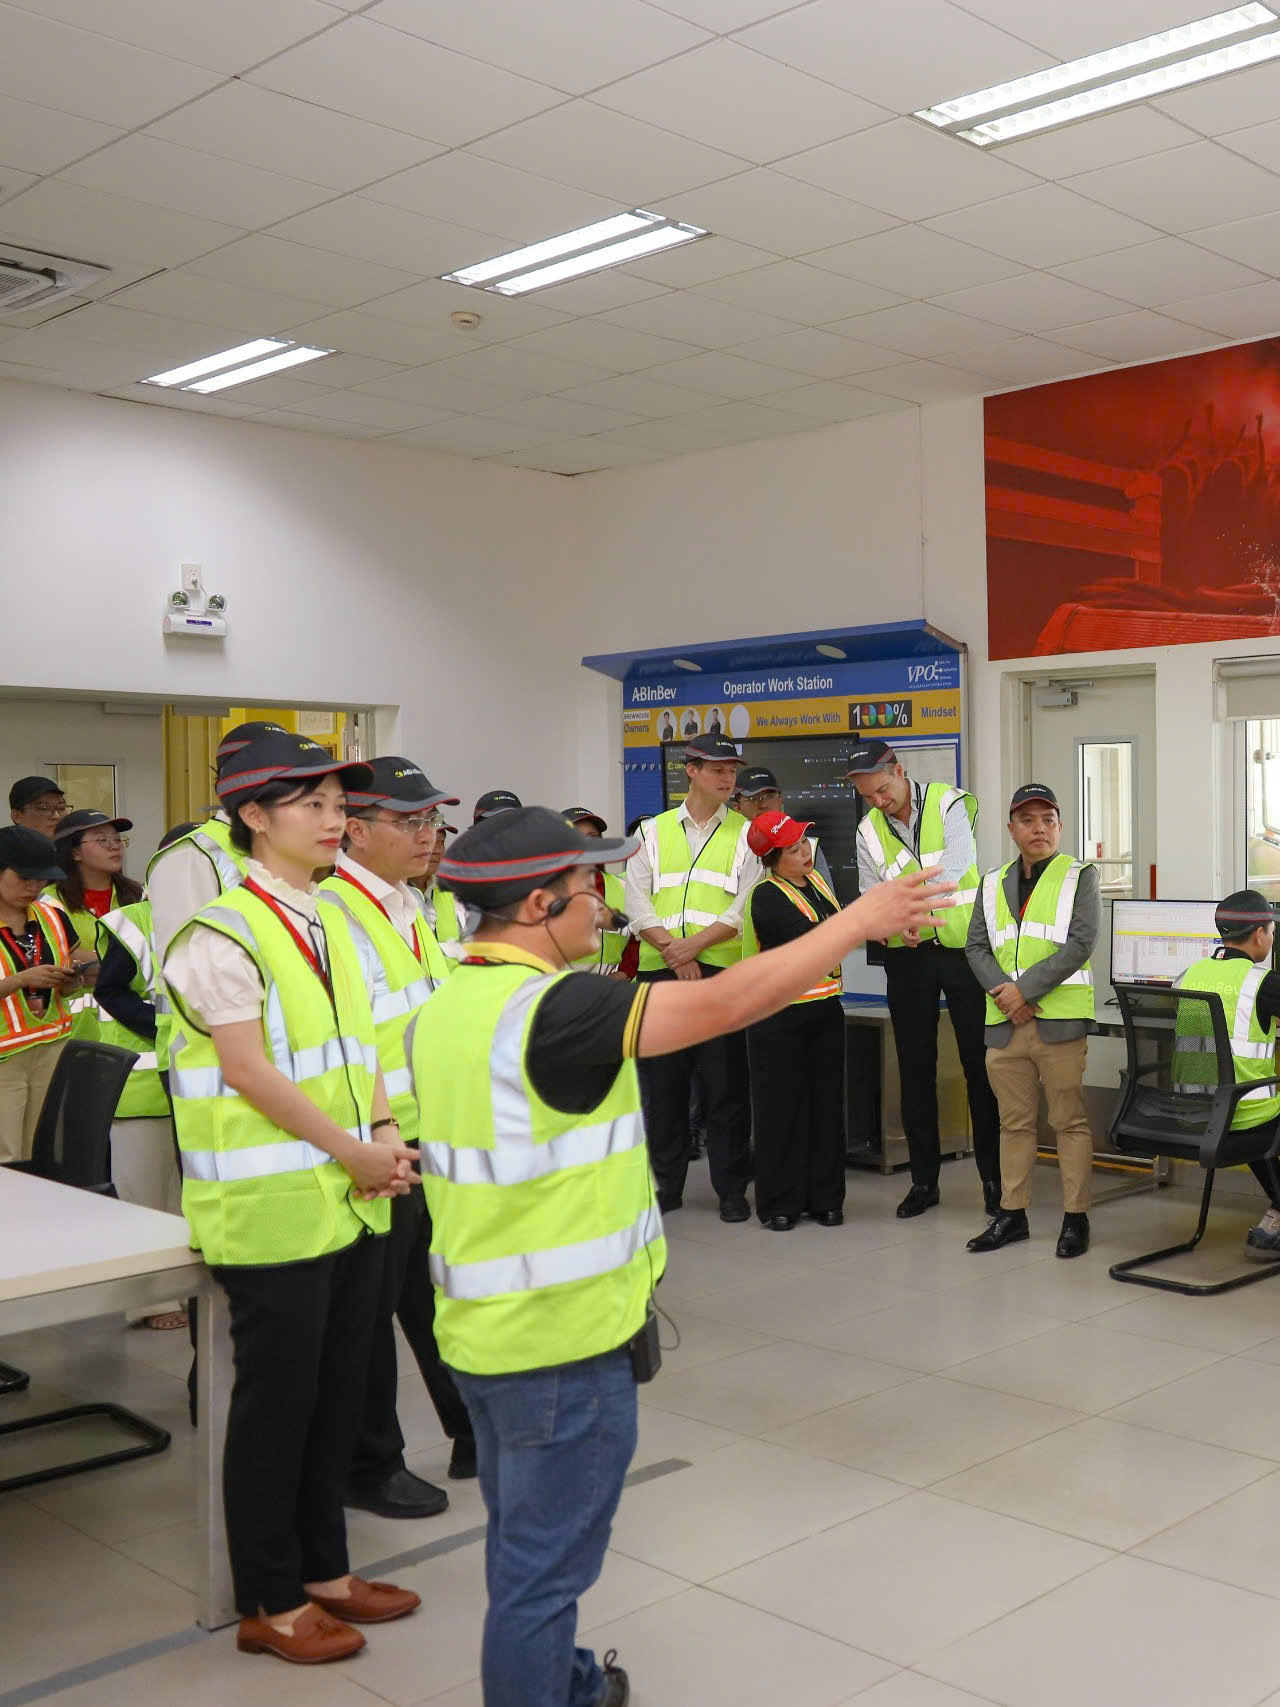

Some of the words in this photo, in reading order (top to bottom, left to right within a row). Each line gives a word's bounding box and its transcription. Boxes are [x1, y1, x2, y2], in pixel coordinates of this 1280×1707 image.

[723, 680, 766, 698] Operator
[768, 677, 794, 693] Work
[797, 675, 833, 691] Station
[756, 716, 769, 727] We
[770, 714, 798, 728] Always
[800, 713, 821, 725] Work
[822, 713, 841, 724] With
[921, 706, 957, 718] Mindset
